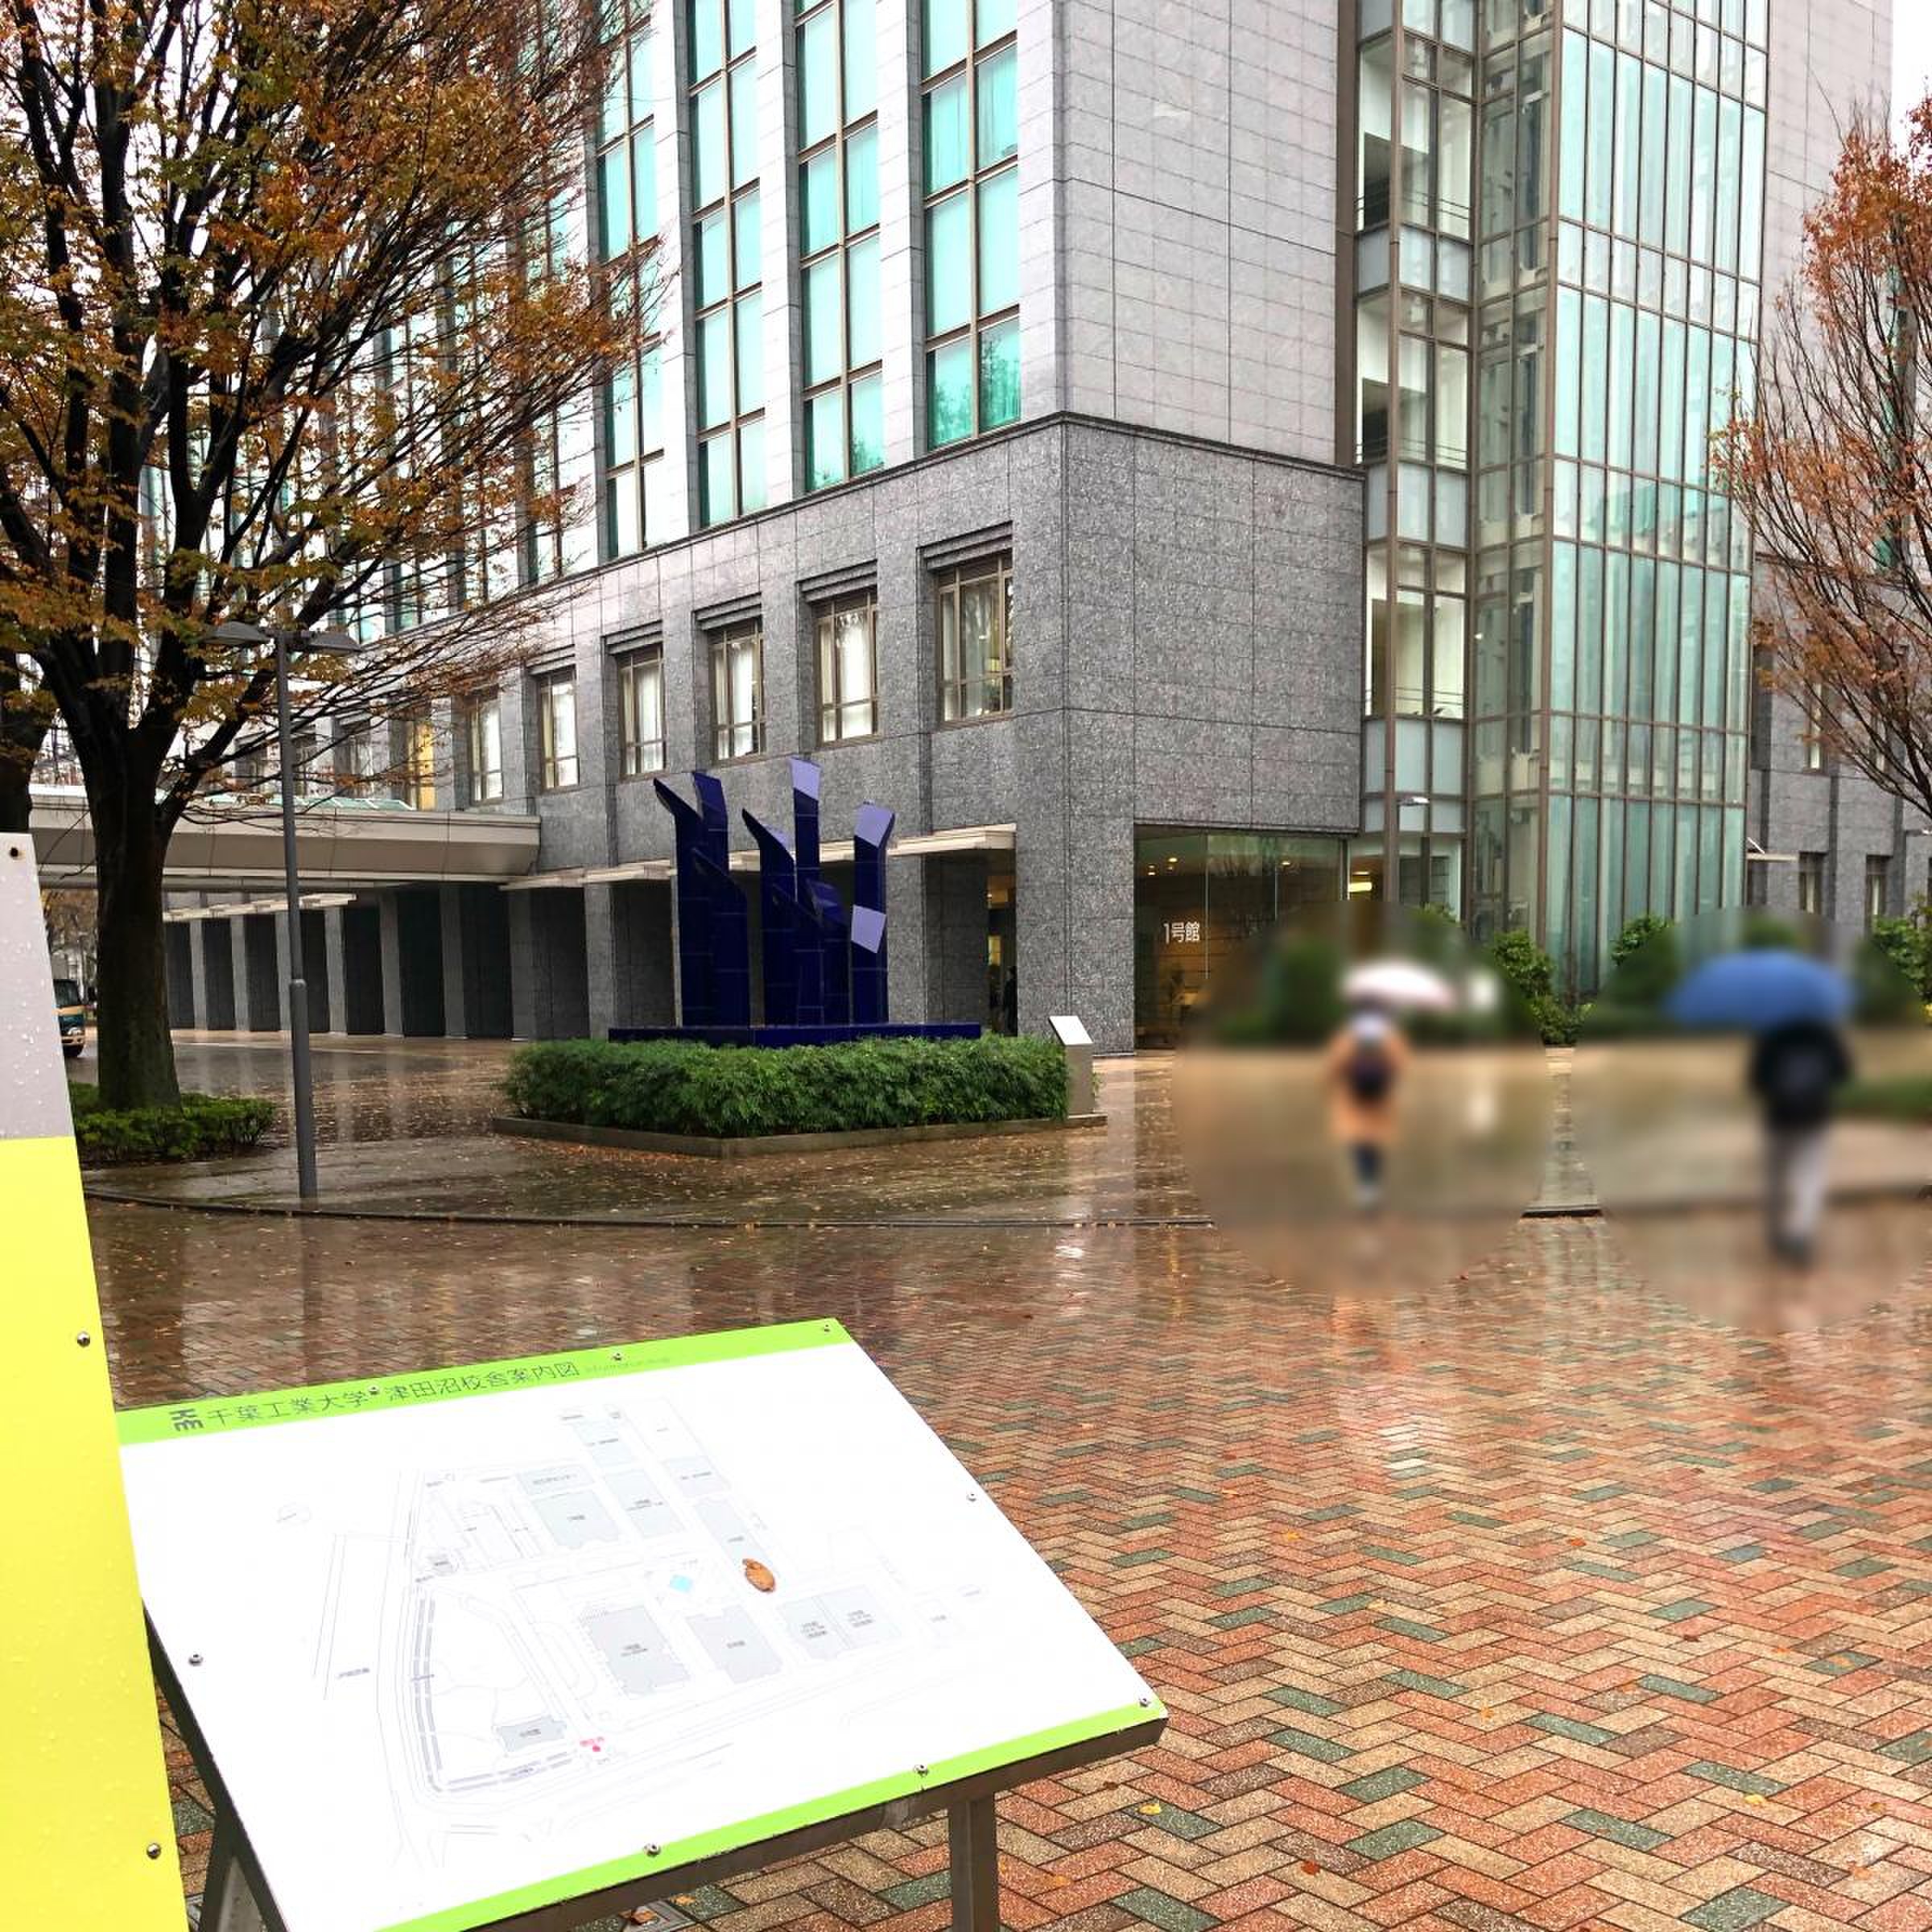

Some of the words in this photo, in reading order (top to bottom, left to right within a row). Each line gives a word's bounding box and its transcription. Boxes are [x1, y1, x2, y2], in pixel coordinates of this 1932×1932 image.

[1163, 921, 1200, 944] 1号館
[207, 1390, 369, 1426] 千葉工業大学
[385, 1360, 580, 1401] 津田沼校舎案内図
